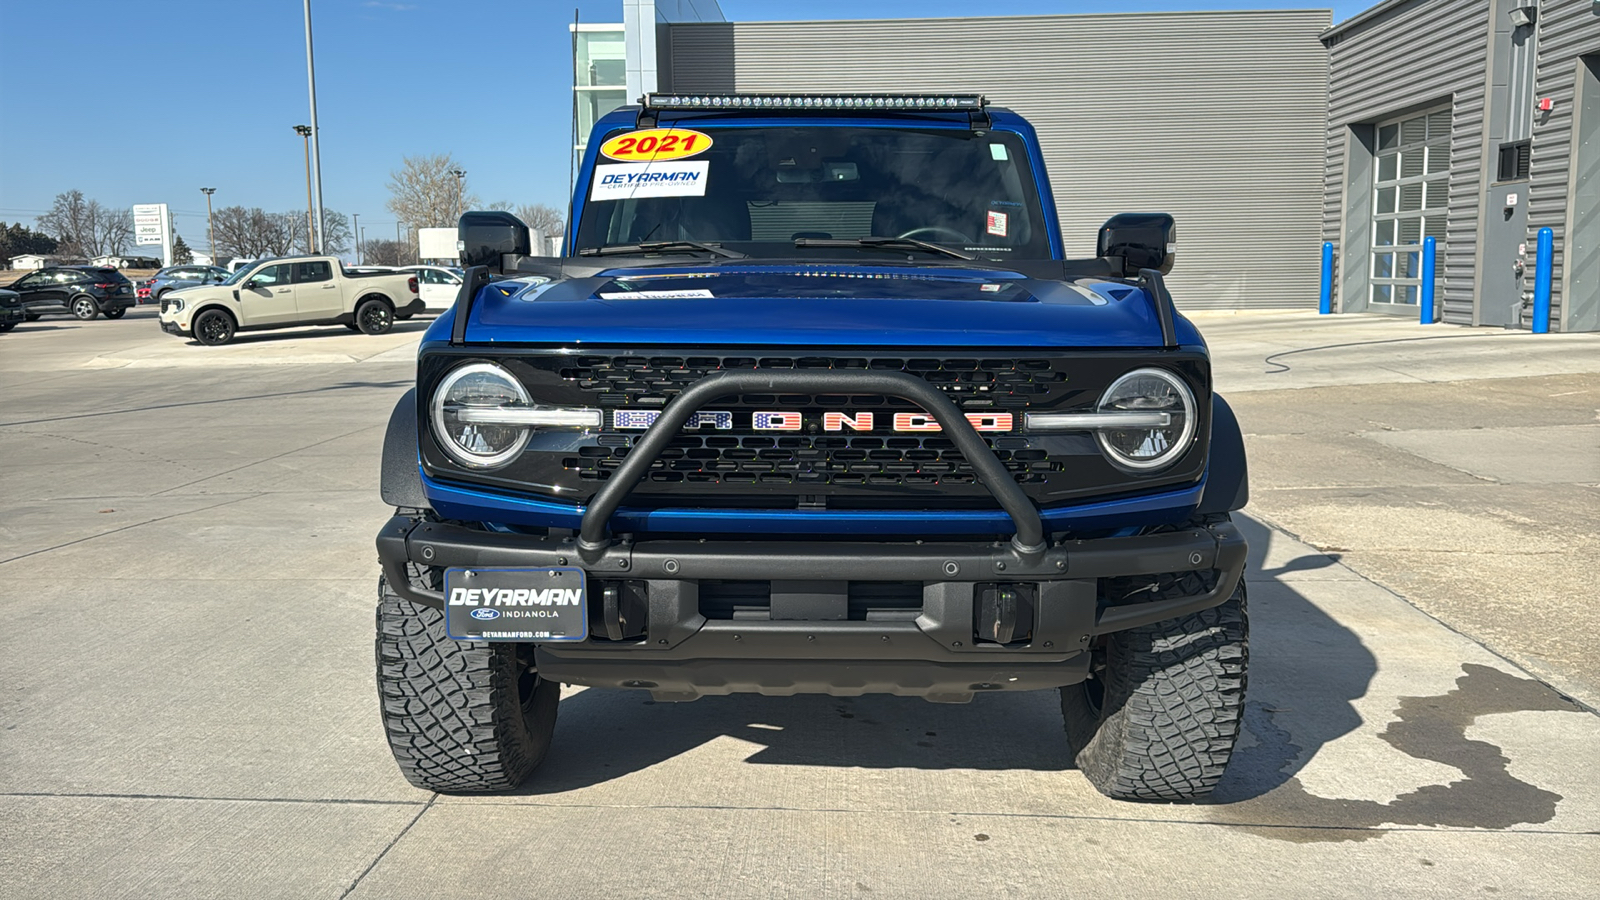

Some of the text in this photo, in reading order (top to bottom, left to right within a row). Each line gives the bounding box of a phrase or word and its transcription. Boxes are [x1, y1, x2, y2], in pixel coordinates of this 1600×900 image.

[612, 134, 698, 156] 2021
[601, 171, 700, 185] DEYARMAN
[607, 180, 697, 190] CERTIFIED PRE-OWNED
[613, 409, 1013, 432] BRONCO
[448, 587, 582, 607] DEYARMAN
[473, 608, 559, 619] Ford INDIANOLA
